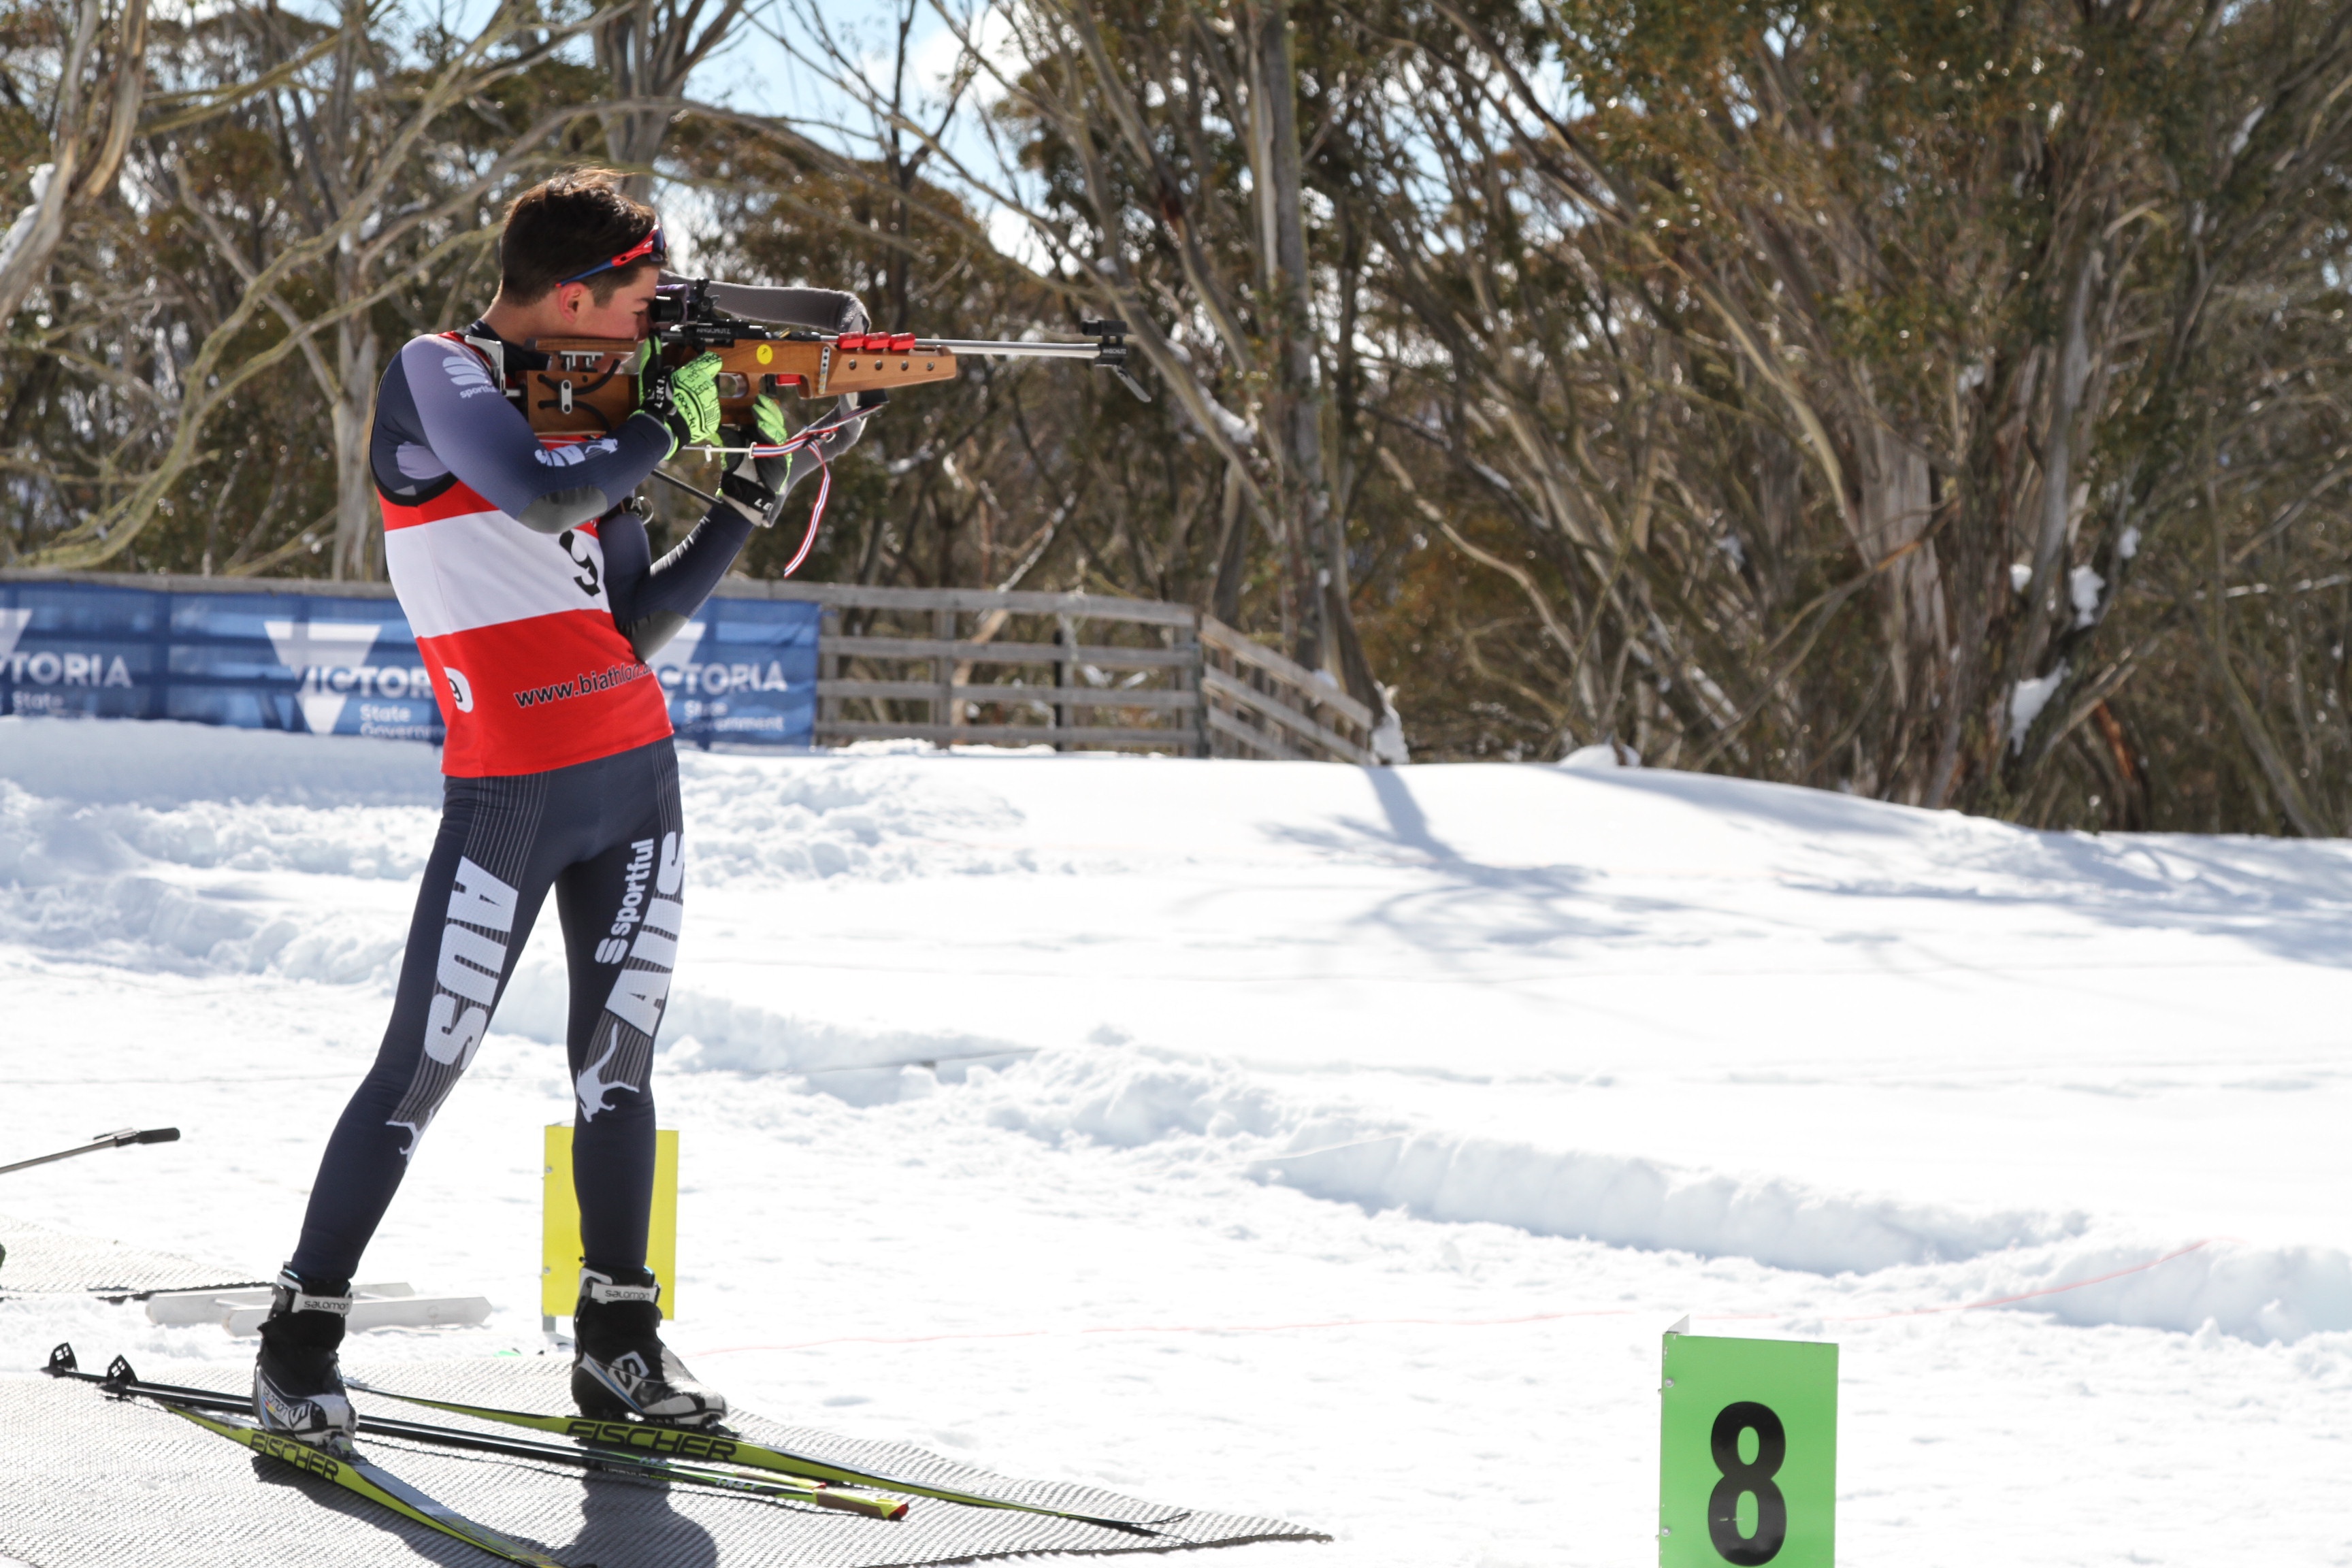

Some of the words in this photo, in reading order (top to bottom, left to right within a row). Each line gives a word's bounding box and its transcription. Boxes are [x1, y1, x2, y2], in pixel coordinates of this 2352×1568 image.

[653, 378, 666, 409] LEKI
[10, 651, 133, 689] TORIA
[289, 664, 435, 700] VICTOR
[657, 660, 789, 696] CTORIA
[359, 703, 412, 723] State
[610, 838, 655, 938] sportful
[424, 855, 519, 1071] AUS
[250, 1433, 340, 1482] FISCHER
[566, 1420, 737, 1463] FISCHER
[1708, 1401, 1787, 1567] 8
